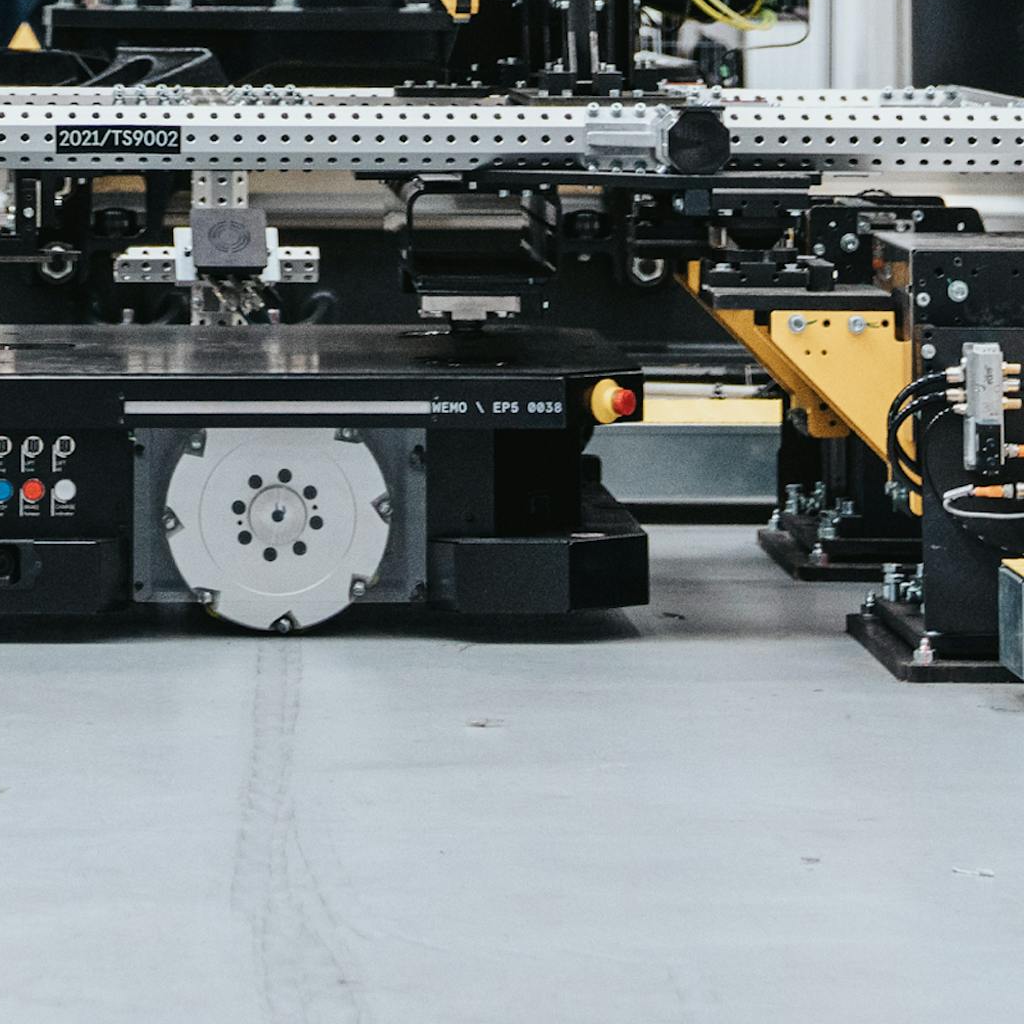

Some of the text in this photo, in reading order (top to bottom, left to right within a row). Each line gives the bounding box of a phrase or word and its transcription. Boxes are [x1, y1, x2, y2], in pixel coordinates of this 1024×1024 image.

[59, 129, 179, 147] 2021/TS9002
[431, 401, 468, 413] WEMO
[527, 401, 563, 414] 0038
